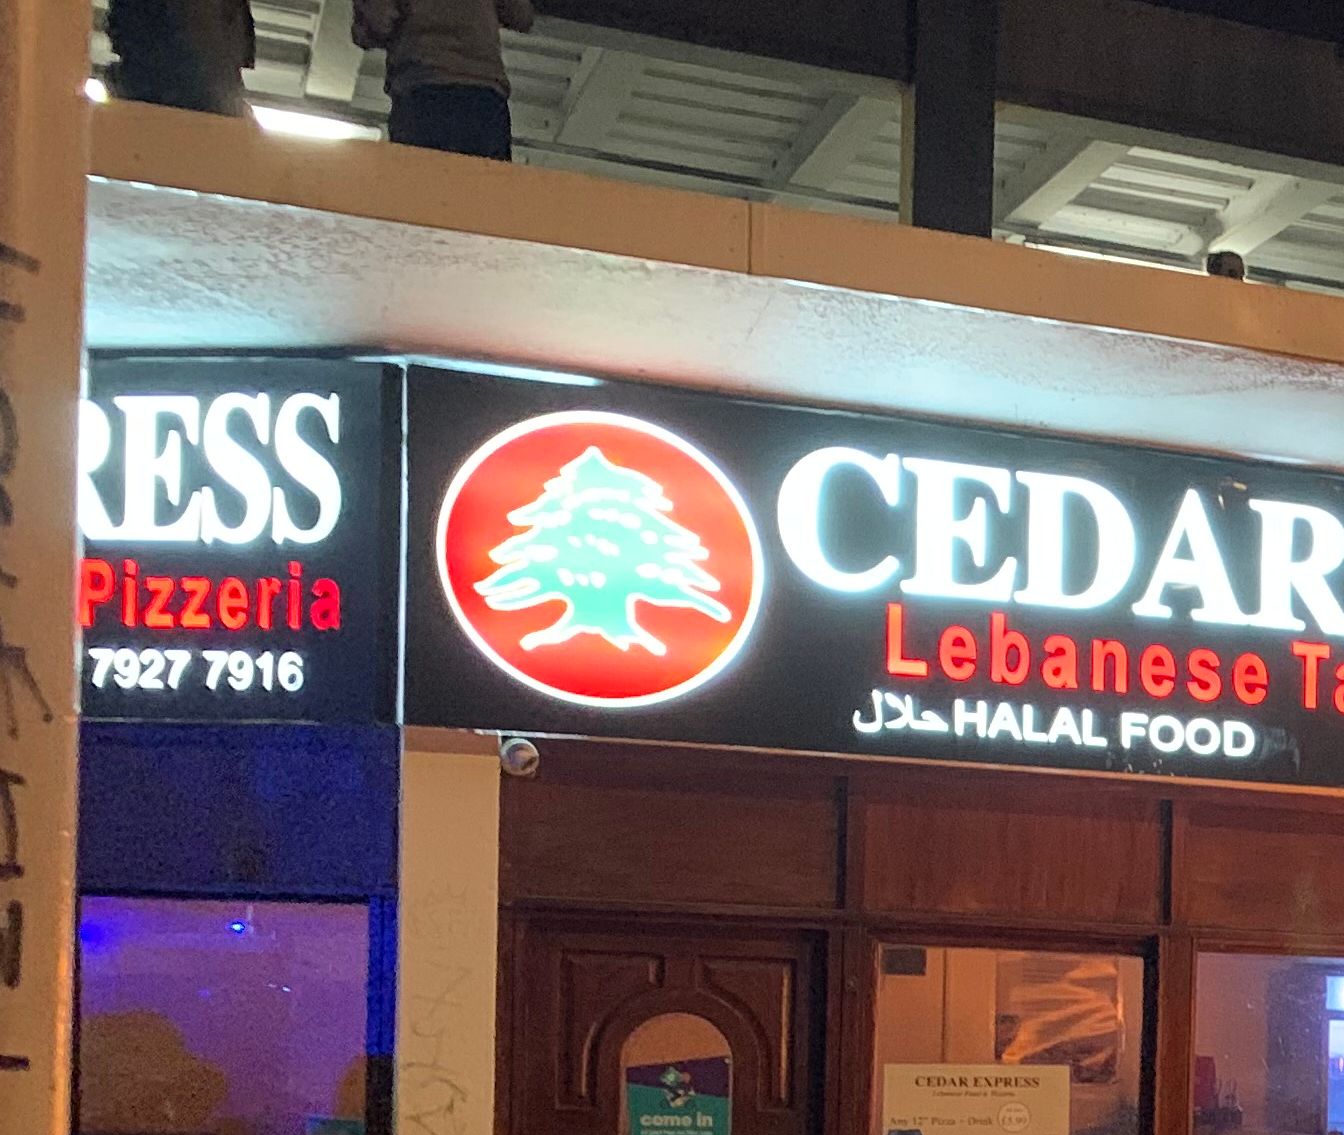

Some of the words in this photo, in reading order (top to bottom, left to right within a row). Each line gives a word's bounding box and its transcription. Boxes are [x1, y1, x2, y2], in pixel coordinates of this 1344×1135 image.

[78, 557, 342, 632] Pizzeria
[88, 646, 192, 692] 7927
[202, 649, 305, 692] 7916
[885, 602, 1271, 706] Lebanese
[852, 688, 951, 733] حلال
[953, 697, 1107, 748] HALAL
[1120, 706, 1256, 758] FOOD
[914, 1075, 969, 1089] CEDAR
[972, 1075, 1041, 1089] EXPRESS
[640, 1114, 693, 1127] come
[696, 1111, 714, 1128] in
